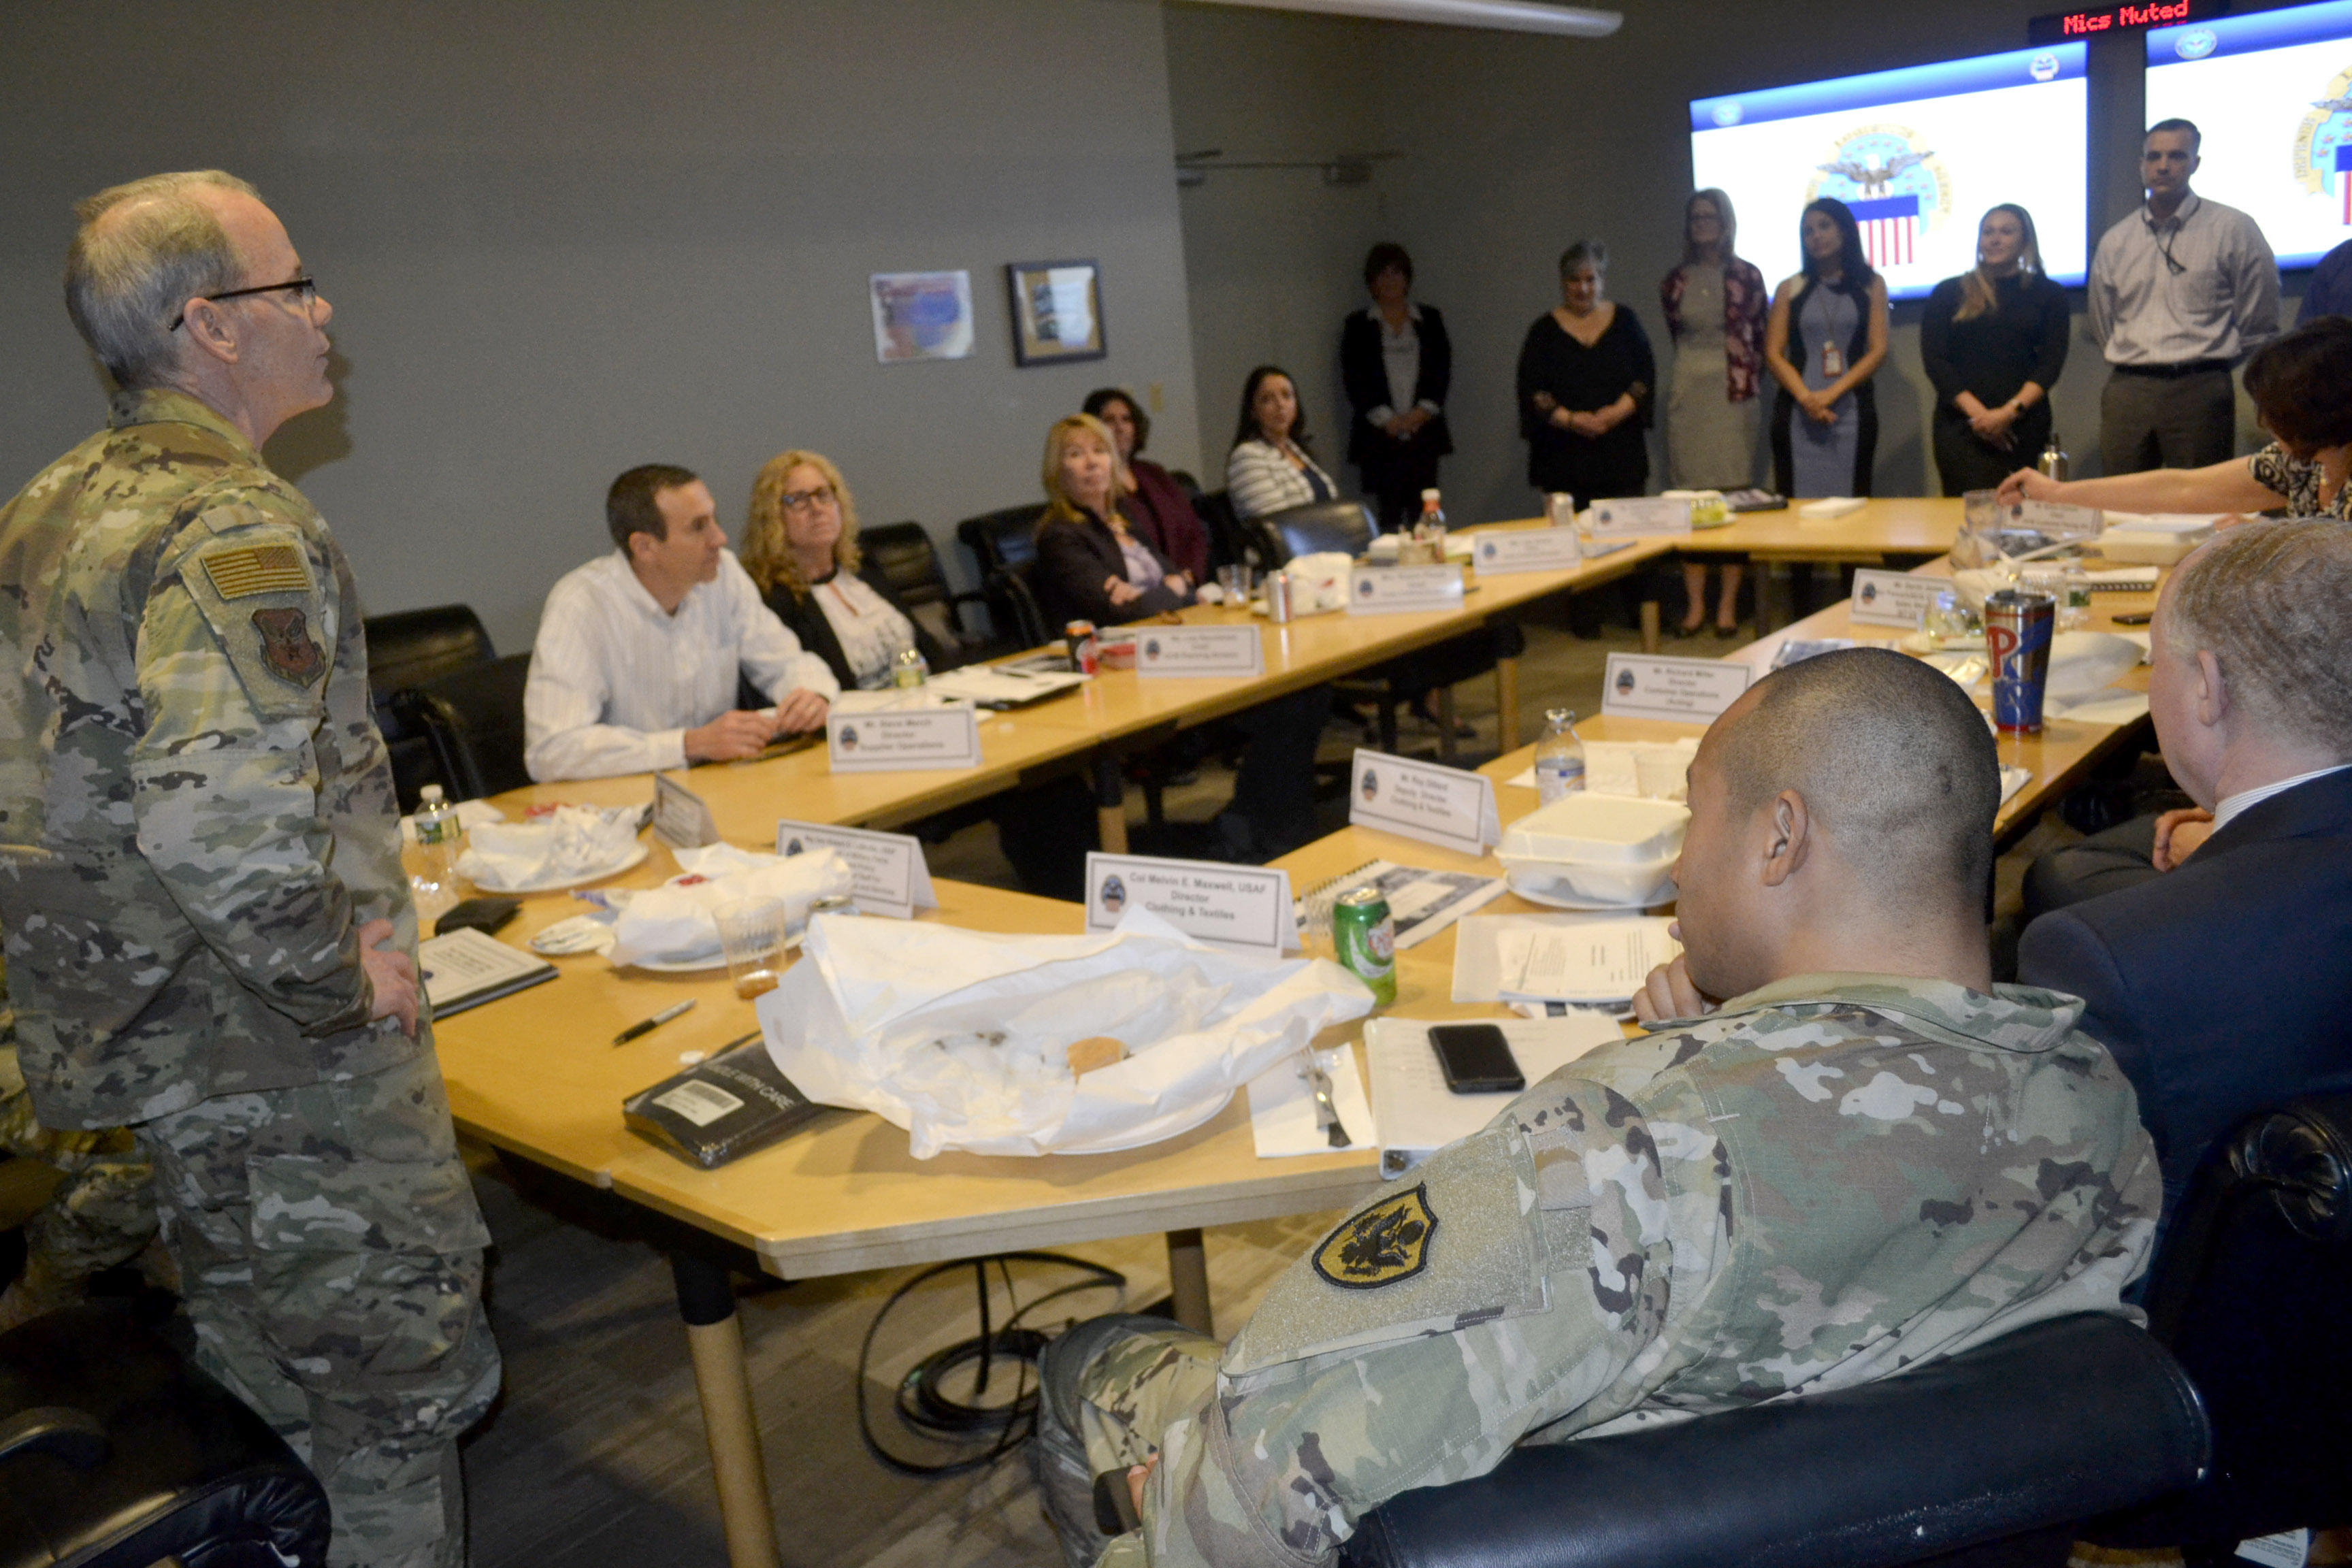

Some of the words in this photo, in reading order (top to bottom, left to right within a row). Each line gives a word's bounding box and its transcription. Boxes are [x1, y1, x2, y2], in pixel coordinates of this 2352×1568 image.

[2063, 14, 2112, 35] Mics
[2119, 0, 2189, 27] Muted
[1390, 796, 1418, 811] Clothing
[1426, 803, 1452, 817] Textiles
[1421, 790, 1447, 803] Director
[1129, 872, 1146, 883] Col
[1147, 873, 1179, 886] Melvin
[1181, 877, 1192, 887] E.
[1194, 878, 1236, 893] Maxwell,
[1238, 881, 1267, 894] USAF
[1171, 889, 1210, 903] Director
[1145, 899, 1186, 917] Clothing
[1188, 905, 1196, 915] &
[1198, 906, 1235, 921] Textiles
[759, 1085, 796, 1111] CARE
